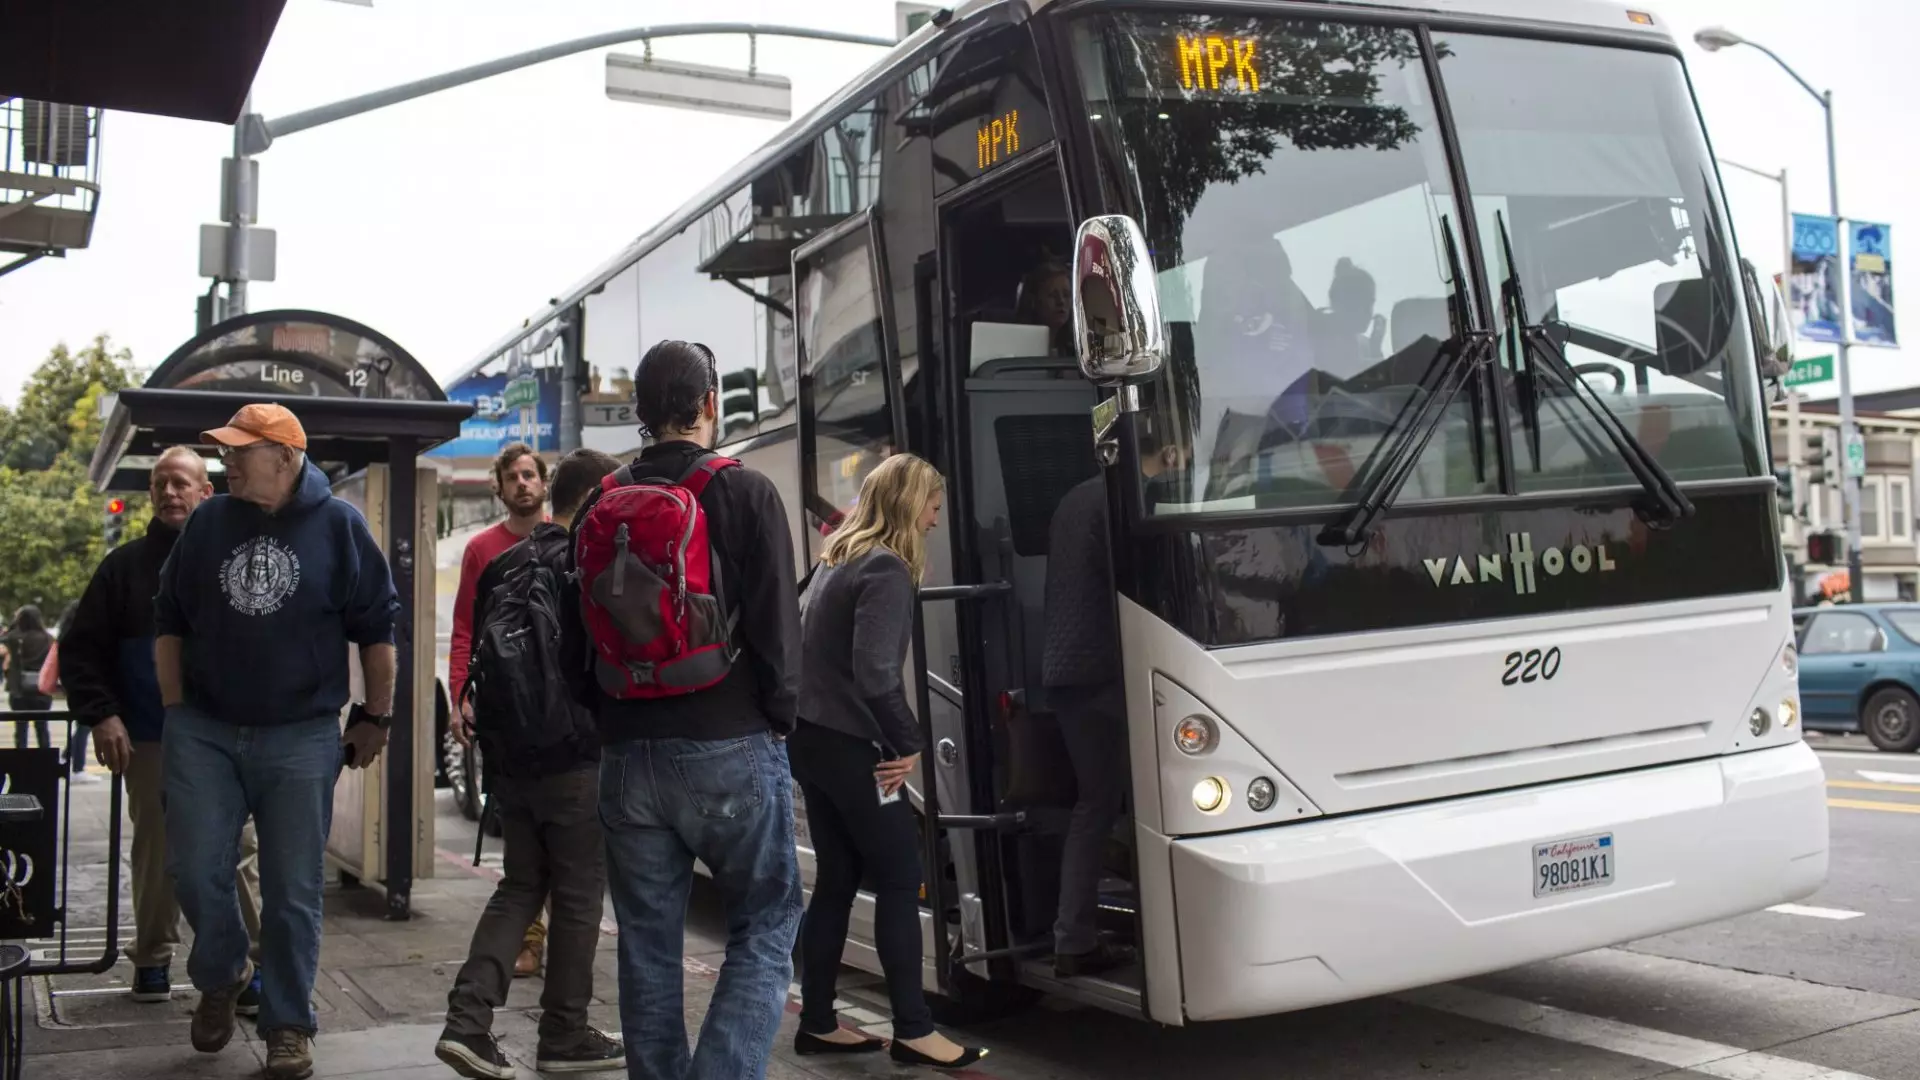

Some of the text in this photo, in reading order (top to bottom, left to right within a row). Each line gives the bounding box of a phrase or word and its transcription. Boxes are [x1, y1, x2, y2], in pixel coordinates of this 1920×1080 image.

[1177, 36, 1259, 92] MPK
[977, 110, 1019, 169] MPK
[260, 364, 368, 387] Line 12
[1501, 646, 1562, 686] 220
[1550, 843, 1598, 859] California
[1540, 853, 1610, 889] 98081K1
